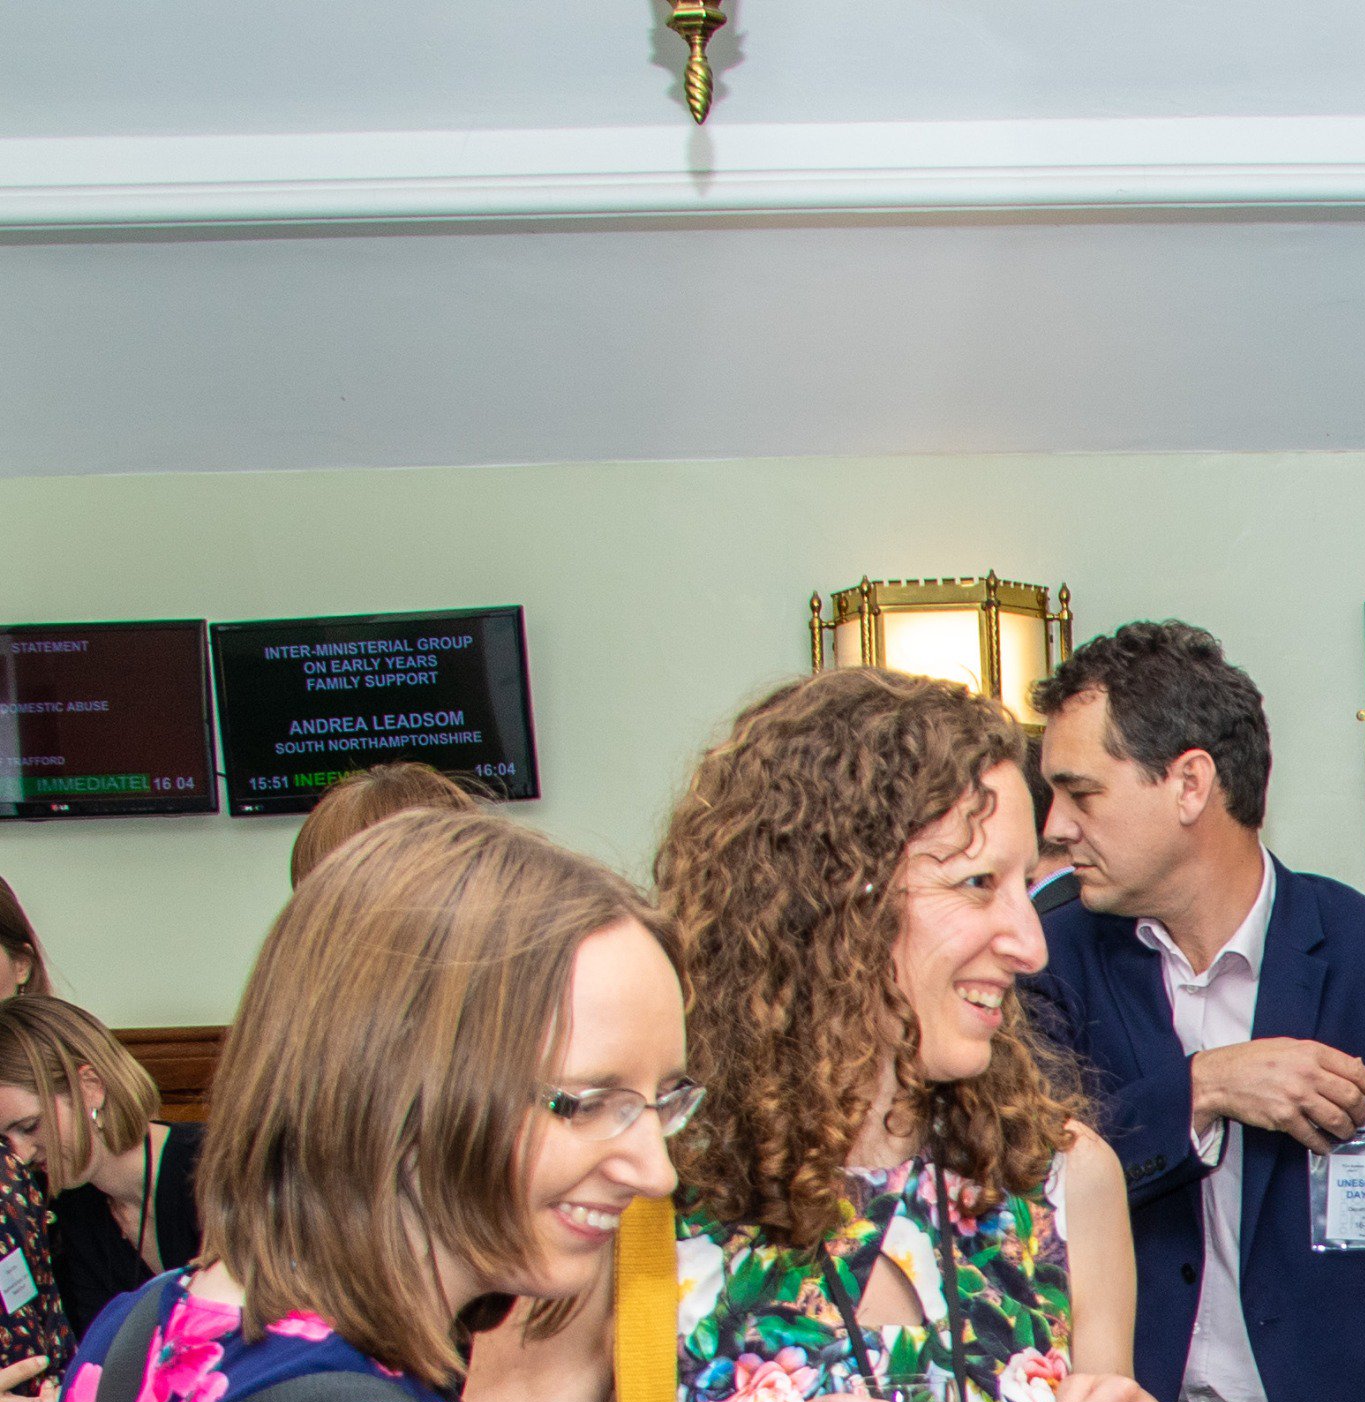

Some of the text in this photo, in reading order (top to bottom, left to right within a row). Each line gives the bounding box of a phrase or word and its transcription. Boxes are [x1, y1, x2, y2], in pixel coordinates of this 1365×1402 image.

[11, 640, 89, 653] STATEMENT
[264, 635, 473, 660] INTER-MINISTERIAL GROUP
[304, 654, 438, 675] ON EARLY YEARS
[307, 671, 439, 691] FAMILY SUPPORT
[0, 701, 109, 714] DOMESTIC ABUSE
[289, 710, 465, 736] ANDREA LEADSOM
[275, 731, 483, 755] SOUTH NORTHAMPTONSHIRE
[249, 776, 290, 790] 15:51
[475, 762, 516, 777] 16:04
